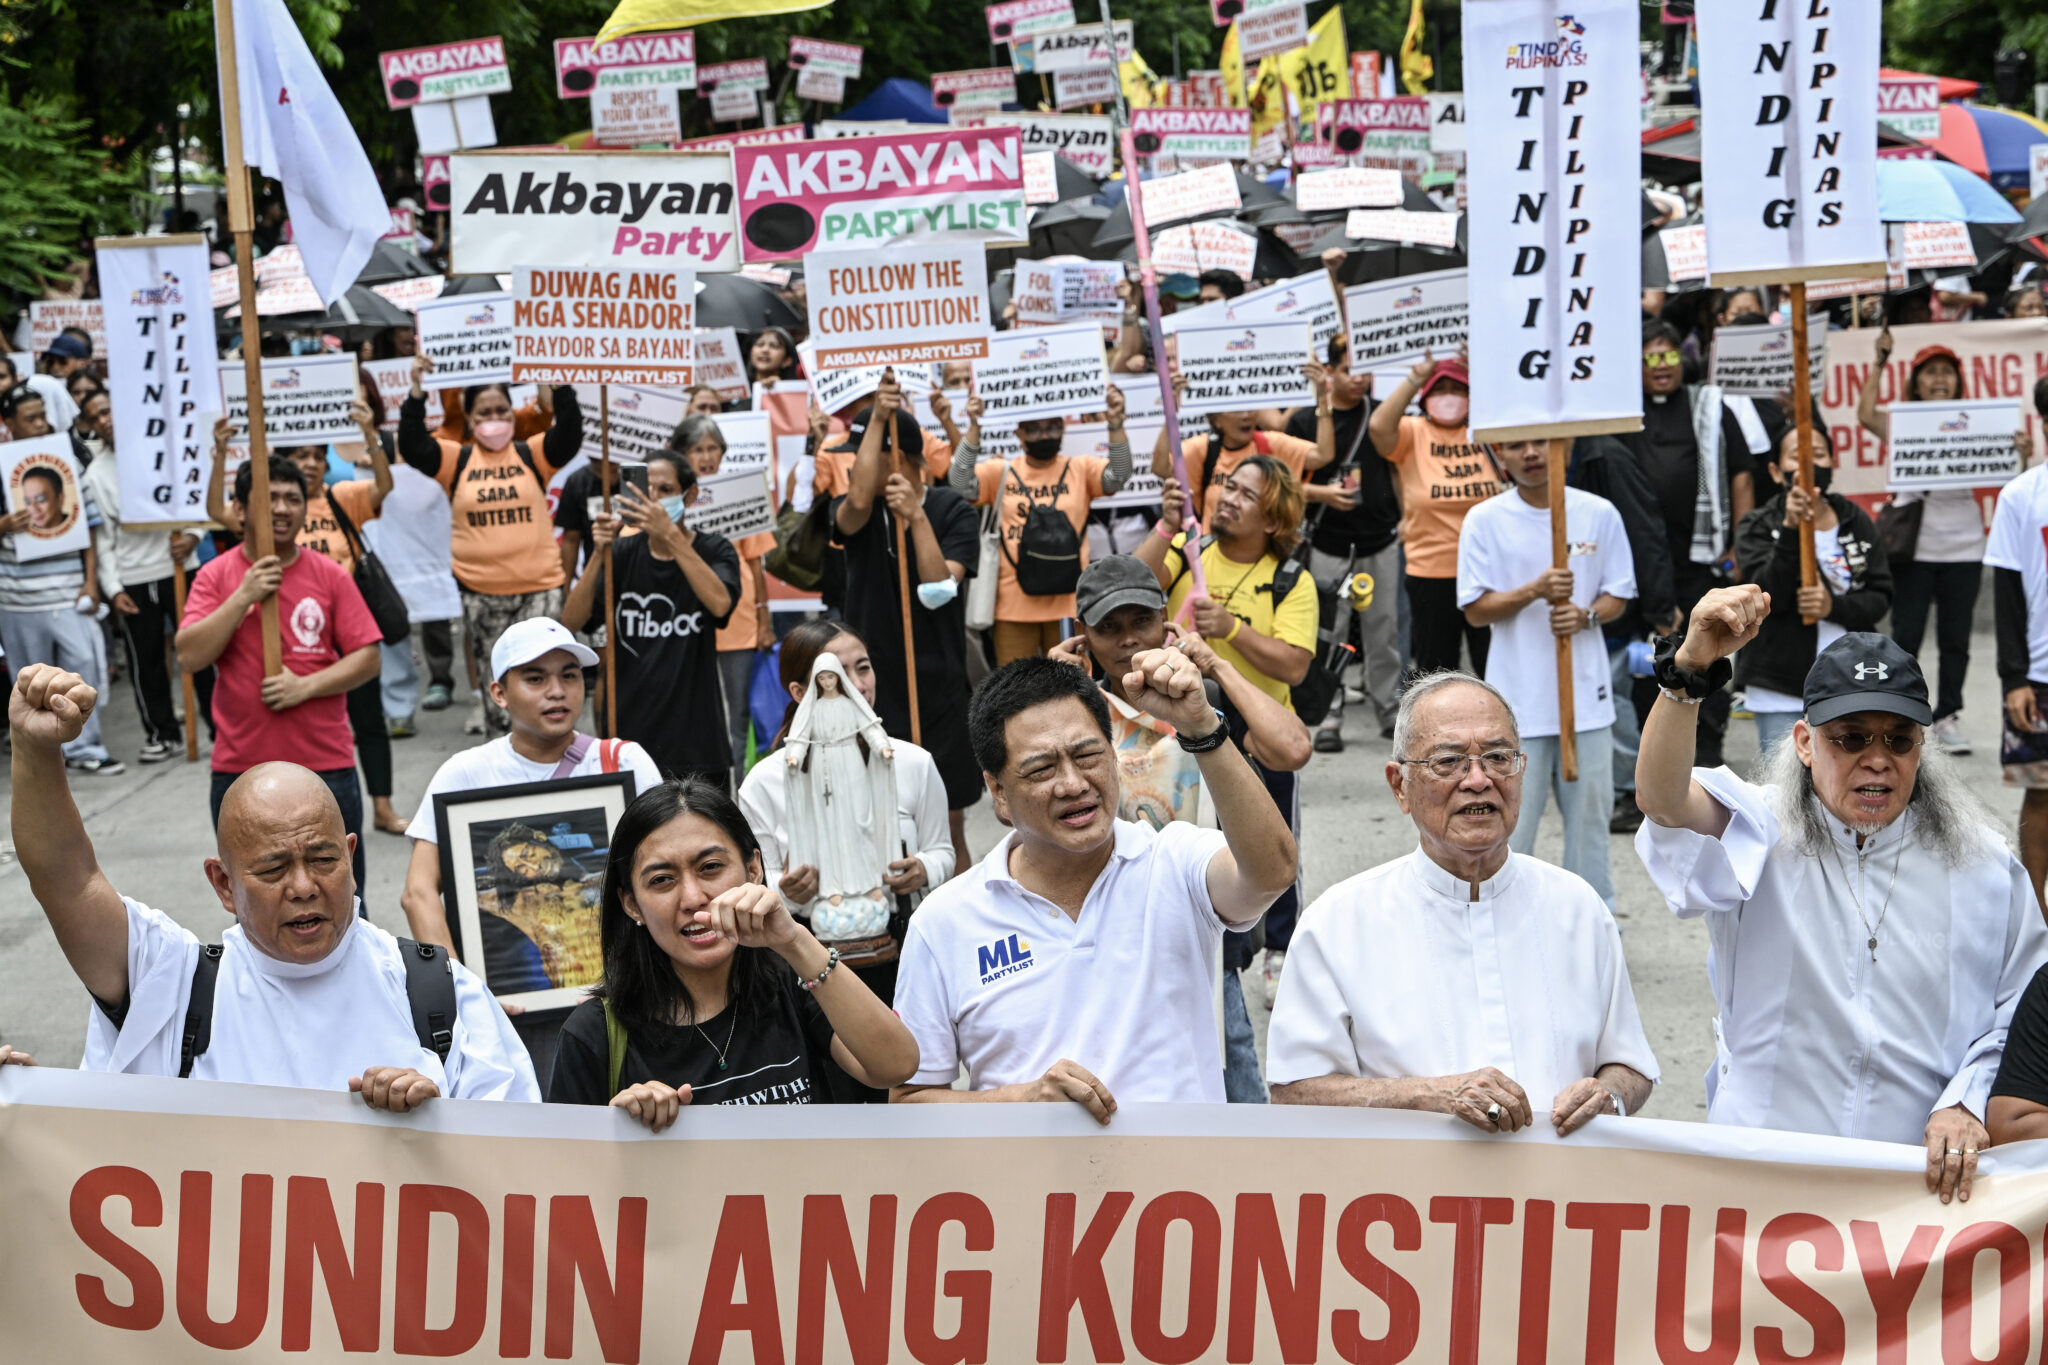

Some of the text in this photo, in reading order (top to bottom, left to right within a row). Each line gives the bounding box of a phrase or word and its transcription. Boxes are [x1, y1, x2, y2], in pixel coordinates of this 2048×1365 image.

[562, 37, 693, 68] AKBAYAN
[1040, 32, 1127, 52] Akbayn
[387, 42, 504, 78] AKBAYAN
[423, 69, 507, 95] PARTYLIST
[599, 68, 693, 87] PARTYLIST
[1133, 111, 1249, 133] AKBAYAN
[1754, 0, 1796, 229] INDIG
[1808, 0, 1843, 228] LIPINAS
[1021, 123, 1107, 148] bayan
[744, 137, 1019, 200] AKBAYAN
[463, 172, 734, 223] Akbayan
[824, 201, 1023, 242] PARTYLIST
[1510, 86, 1552, 380] TINDIG
[1563, 80, 1596, 381] PILIPINAS
[612, 226, 732, 262] Party
[530, 270, 677, 301] DUWAG ANG
[829, 260, 963, 296] FOLLOW THE
[514, 301, 691, 331] MGA SENADOR!
[818, 295, 981, 335] CONSTITUTION!
[425, 340, 512, 357] IMPEACHM
[514, 336, 691, 360] TRAYDOR SA BAYAN!
[823, 342, 983, 368] AKBAYAN PARTYLIST
[1356, 331, 1468, 360] TRIAL NGAYON
[378, 371, 408, 389] FOLL
[430, 360, 475, 374] RIAL
[517, 366, 599, 383] AKBAYAN
[601, 368, 688, 385] PARTYLIST
[1184, 364, 1305, 383] IMPEACHMENT
[979, 369, 1103, 395] IMPEACHMENT
[1186, 378, 1310, 400] TRIAL NGAYON!
[170, 312, 203, 507] PILIPINAS
[983, 384, 1105, 410] TRIAL NGAYON!
[136, 316, 173, 505] TINDIG
[229, 402, 352, 419] IMEACHMENT
[1894, 446, 2017, 462] IMPEACHMENT
[1895, 461, 2017, 478] TRIAL NGAYON!
[476, 485, 519, 503] SARA
[466, 506, 533, 527] DUTERTE
[722, 515, 769, 534] AYON!
[978, 933, 1031, 977] ML
[981, 958, 1034, 985] PARTYLIST
[69, 1165, 2048, 1365] SUNDIN ANG KONSTITUSYO
